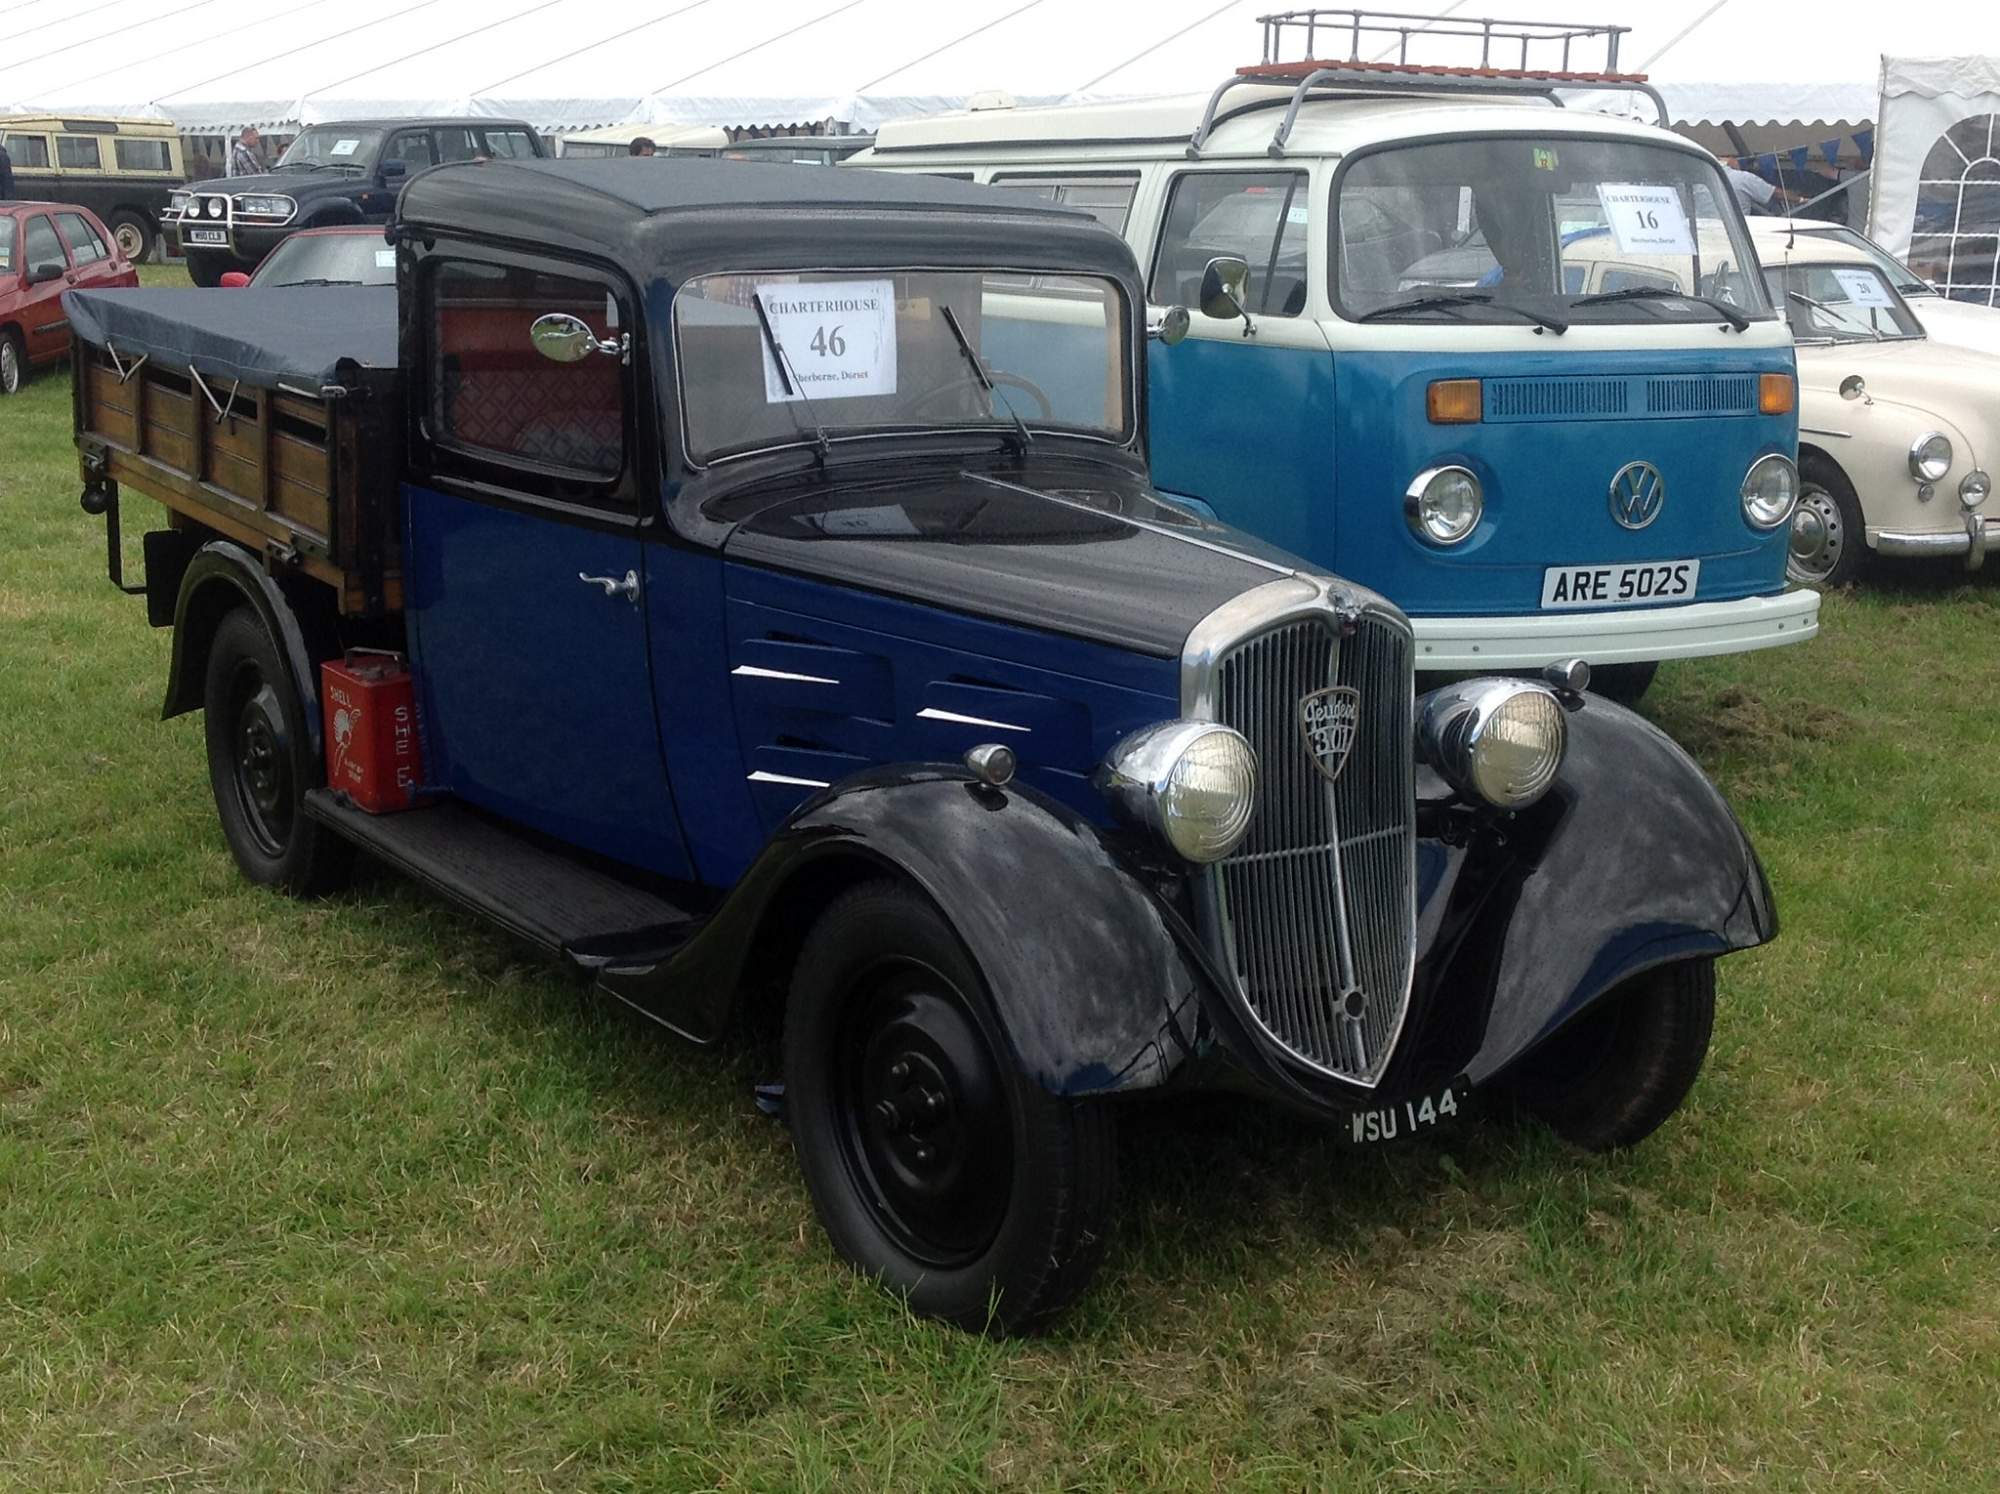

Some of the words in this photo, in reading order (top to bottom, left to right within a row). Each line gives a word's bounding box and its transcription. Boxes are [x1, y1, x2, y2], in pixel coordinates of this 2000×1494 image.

[1636, 210, 1659, 229] 16
[769, 299, 880, 315] CHARTERHOUSE
[810, 325, 846, 357] 46
[1552, 571, 1611, 602] ARE
[1618, 565, 1690, 598] 502S
[330, 686, 352, 708] SHELL
[1314, 727, 1348, 754] 301
[1352, 1108, 1397, 1143] WSU
[1406, 1088, 1457, 1132] 144
